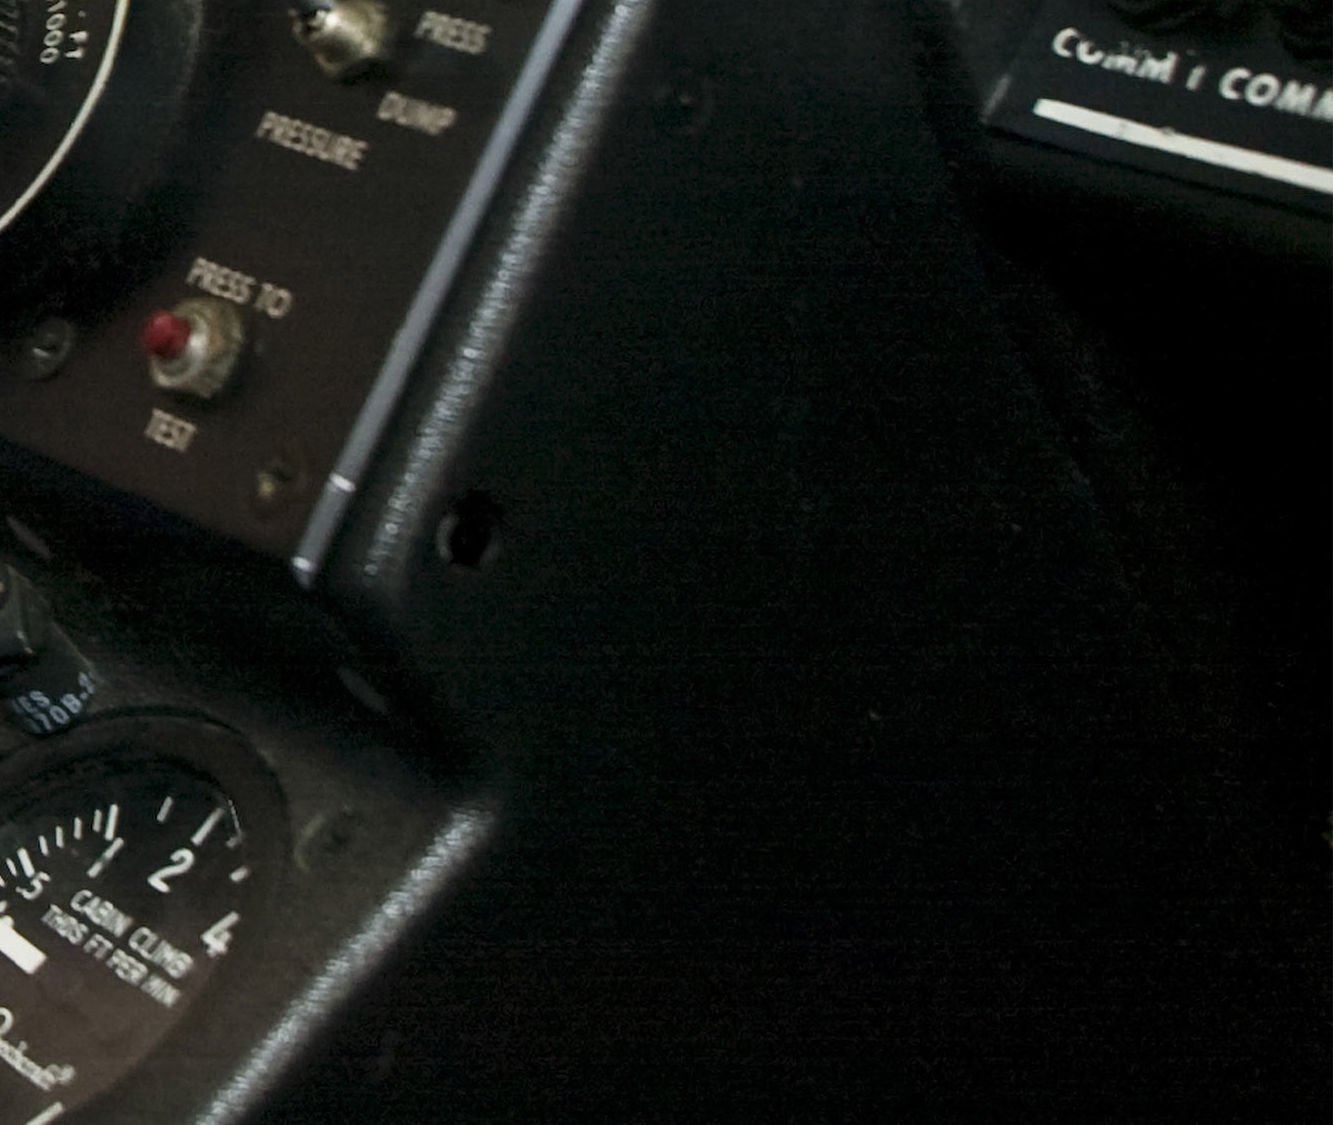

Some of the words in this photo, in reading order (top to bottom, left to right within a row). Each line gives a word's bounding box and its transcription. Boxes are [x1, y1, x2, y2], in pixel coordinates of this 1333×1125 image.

[415, 11, 493, 55] PRESS
[378, 91, 457, 135] DUMP
[257, 111, 369, 171] PRESSURE
[187, 257, 256, 304] PRESS
[256, 283, 293, 318] TO
[145, 408, 197, 452] TEST
[148, 848, 195, 893] 2
[70, 889, 133, 938] CABIN
[128, 926, 195, 980] CLIMB
[201, 910, 240, 958] 4
[83, 932, 114, 960] FT
[107, 948, 148, 986] PER
[141, 974, 182, 1008] MIN
